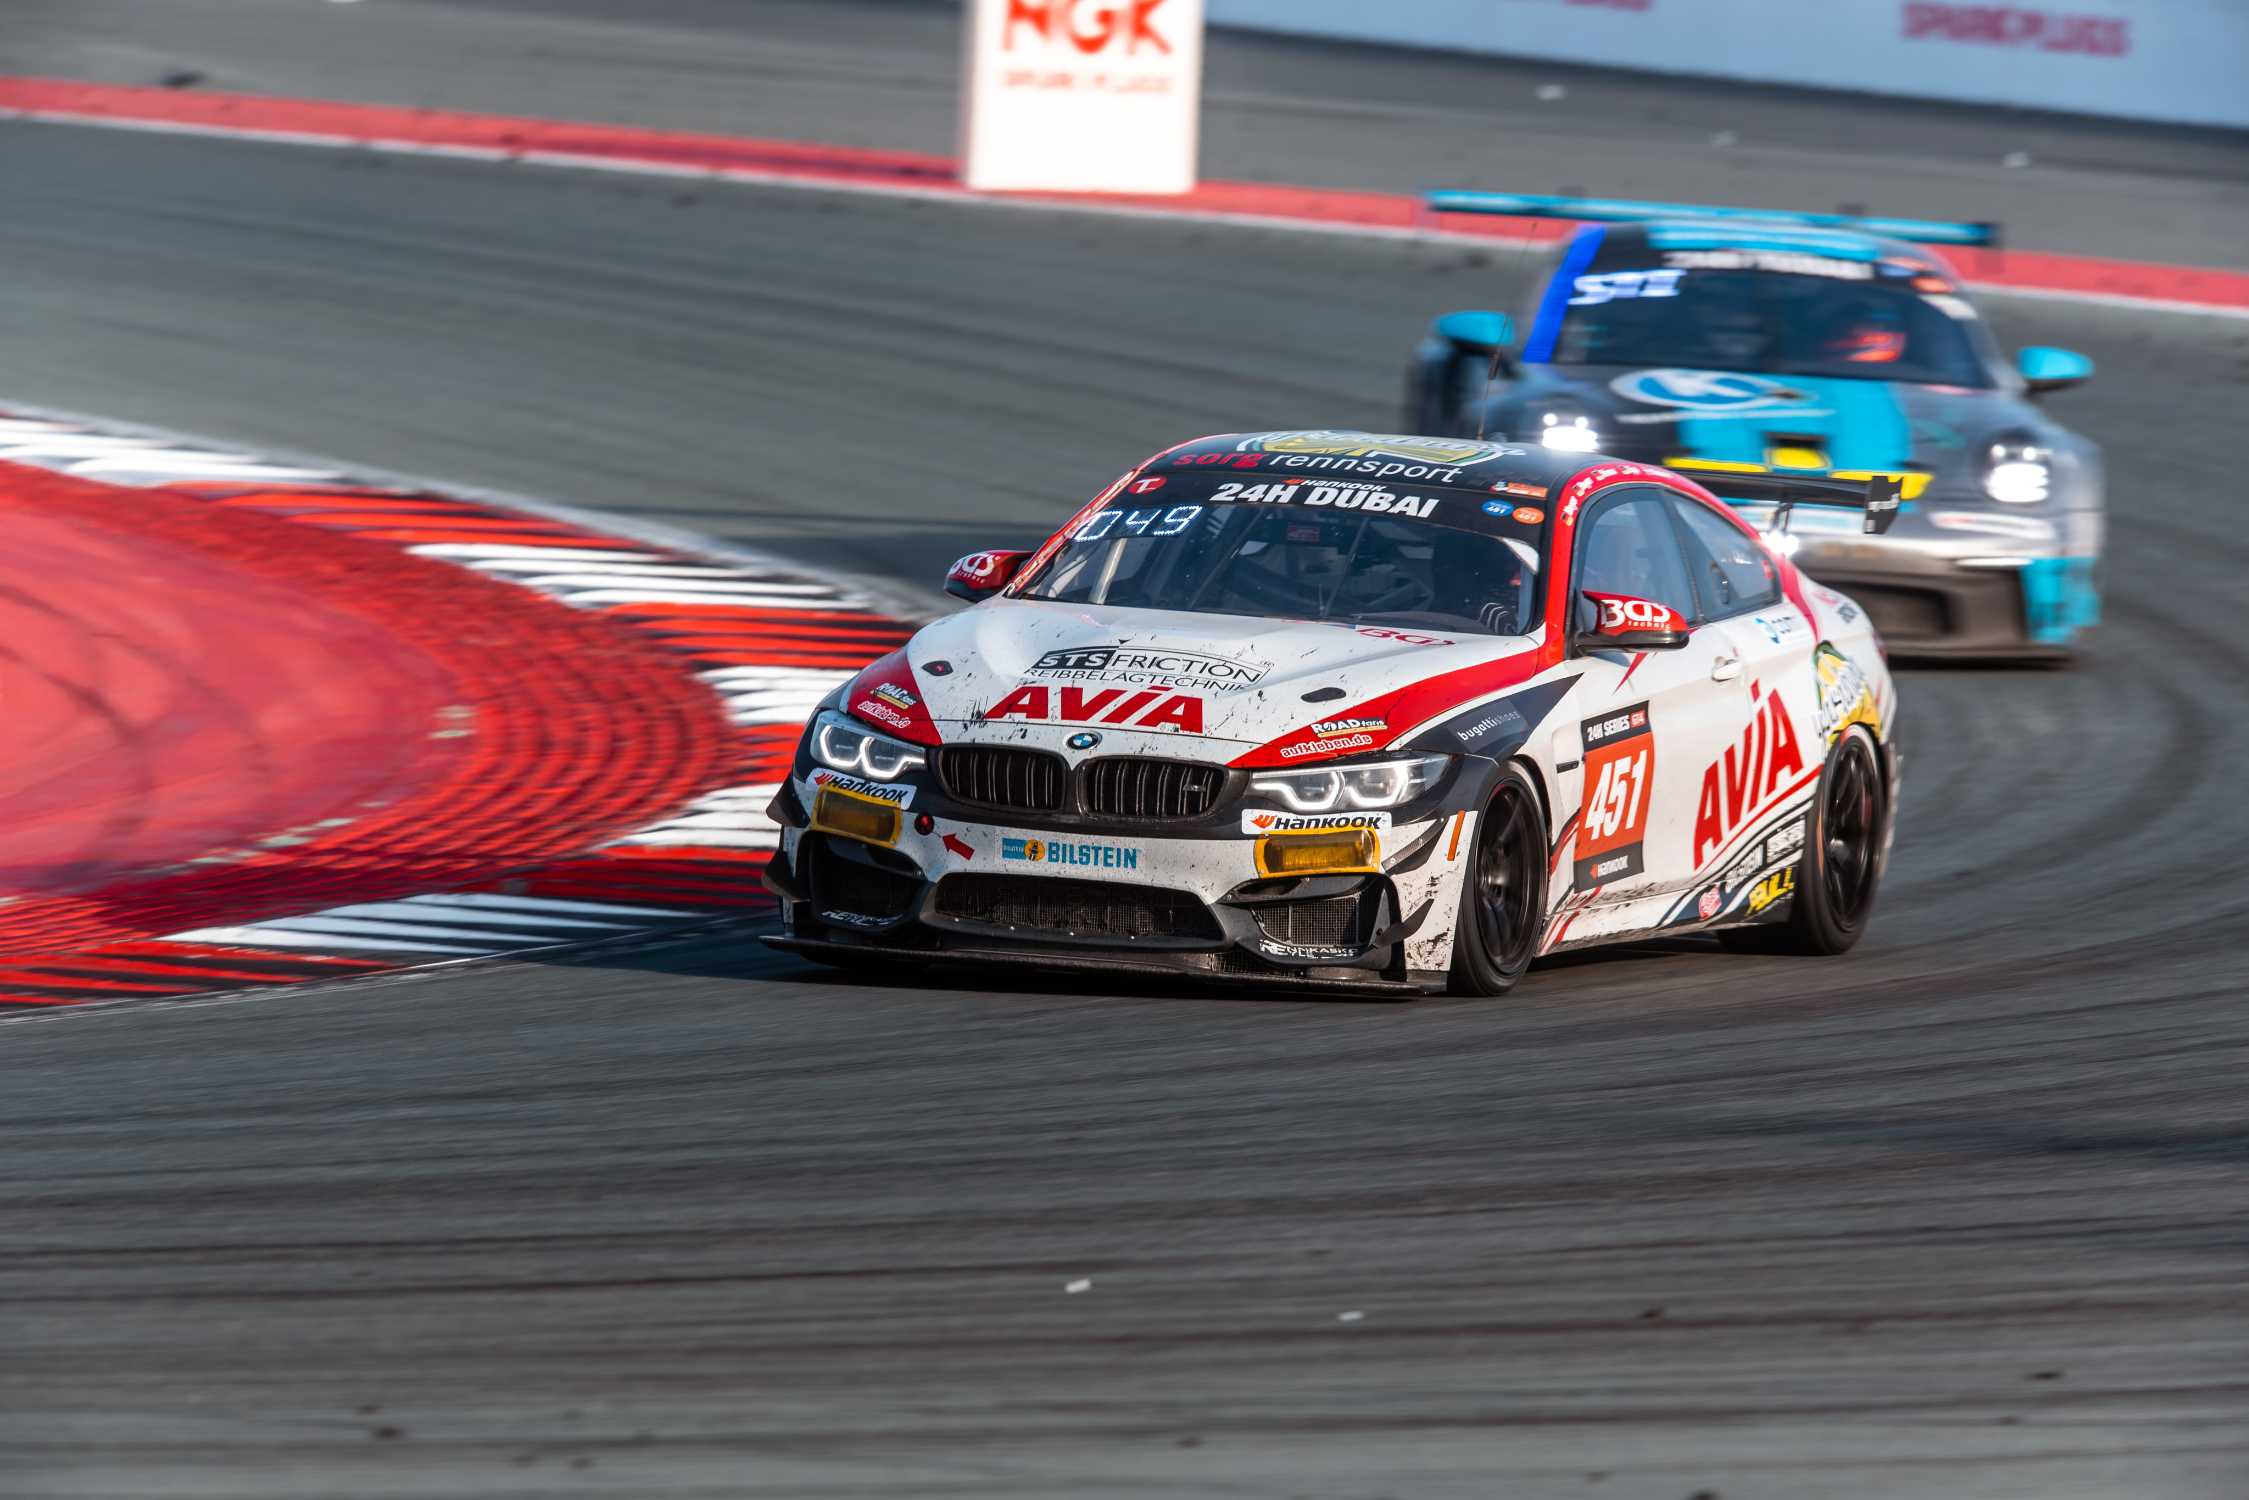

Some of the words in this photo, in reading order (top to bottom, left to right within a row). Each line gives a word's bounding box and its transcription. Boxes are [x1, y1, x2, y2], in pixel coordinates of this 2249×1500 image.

[1003, 0, 1171, 53] NGK
[1173, 452, 1267, 468] sorg
[1269, 453, 1464, 482] rennsport
[1209, 482, 1301, 504] 24H
[1304, 486, 1440, 518] DUBAI
[1073, 505, 1202, 542] 049
[1039, 652, 1109, 668] STS
[1111, 653, 1263, 683] FRICTION
[983, 686, 1203, 734] AVIA
[1280, 734, 1373, 757] aufkleben.de
[1694, 678, 1804, 871] AVIA
[1585, 750, 1648, 840] 451
[1047, 841, 1137, 869] BILSTEIN
